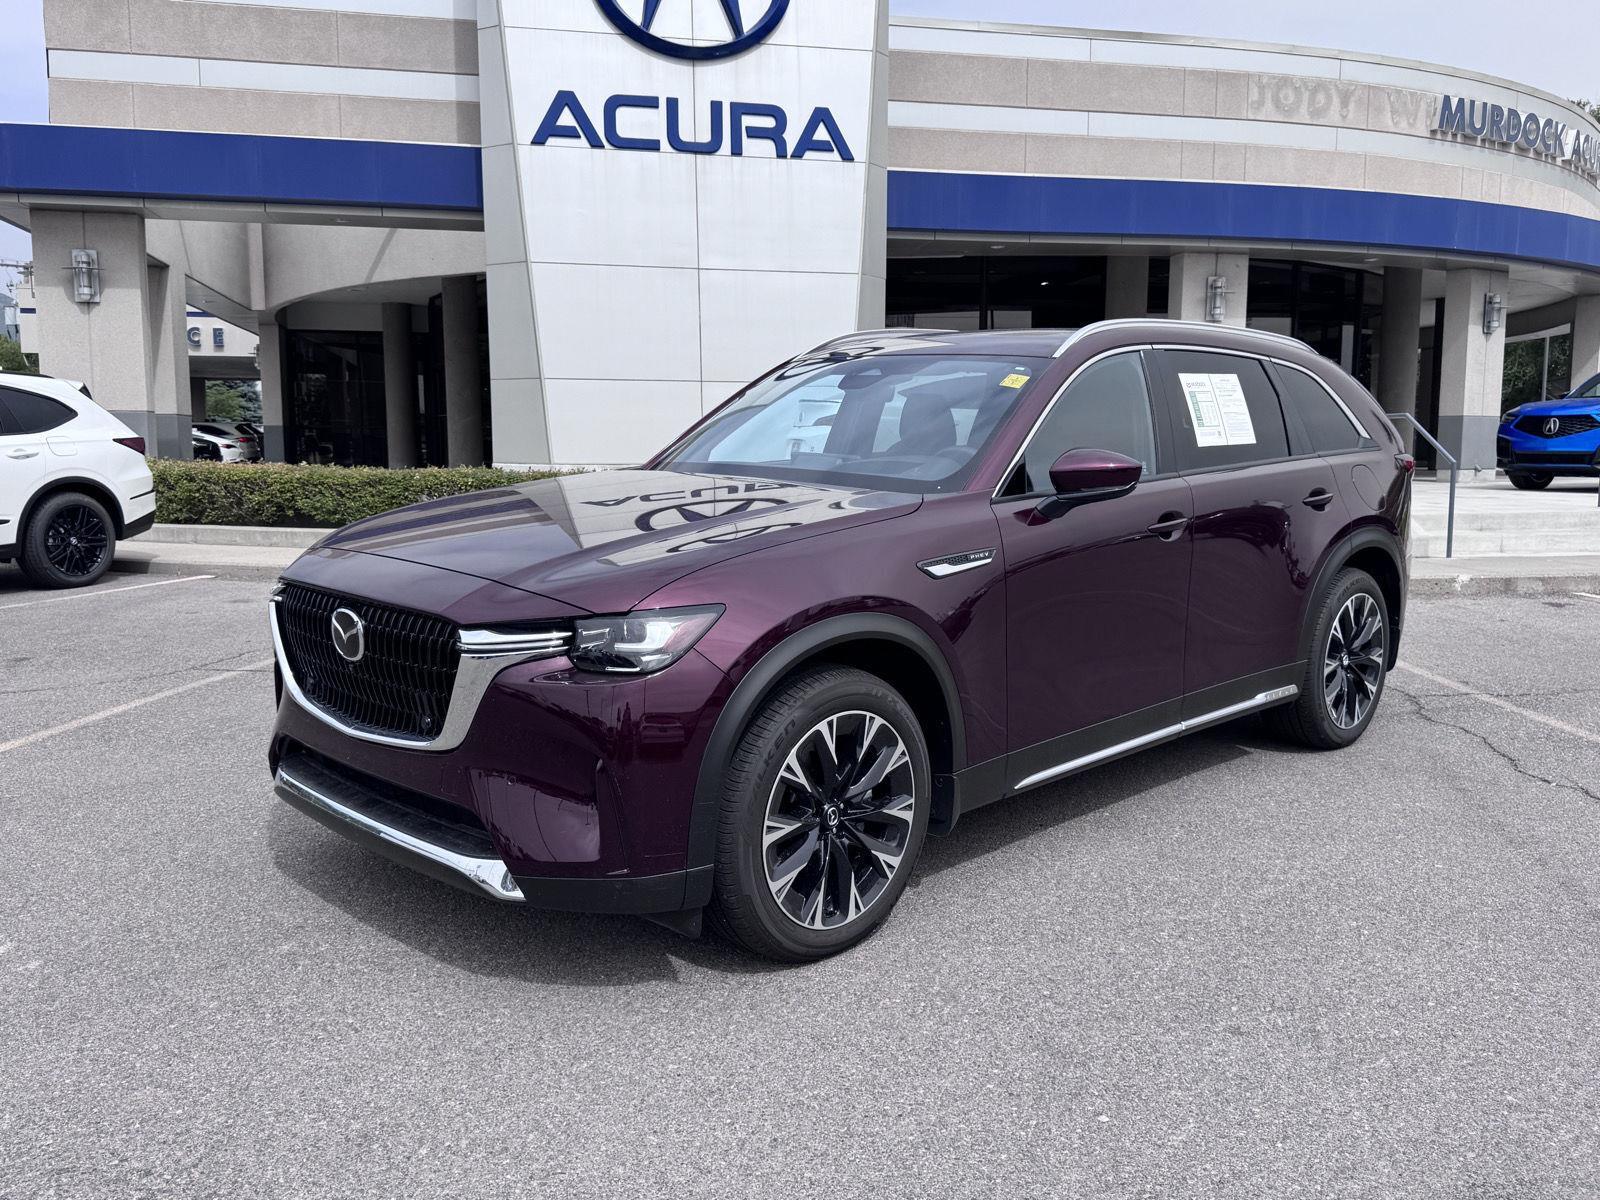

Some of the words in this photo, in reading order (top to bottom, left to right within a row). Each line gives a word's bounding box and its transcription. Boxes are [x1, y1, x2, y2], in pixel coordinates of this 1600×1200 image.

[530, 90, 855, 161] ACURA
[1438, 95, 1566, 157] MURDOCK
[970, 551, 989, 560] PHEV
